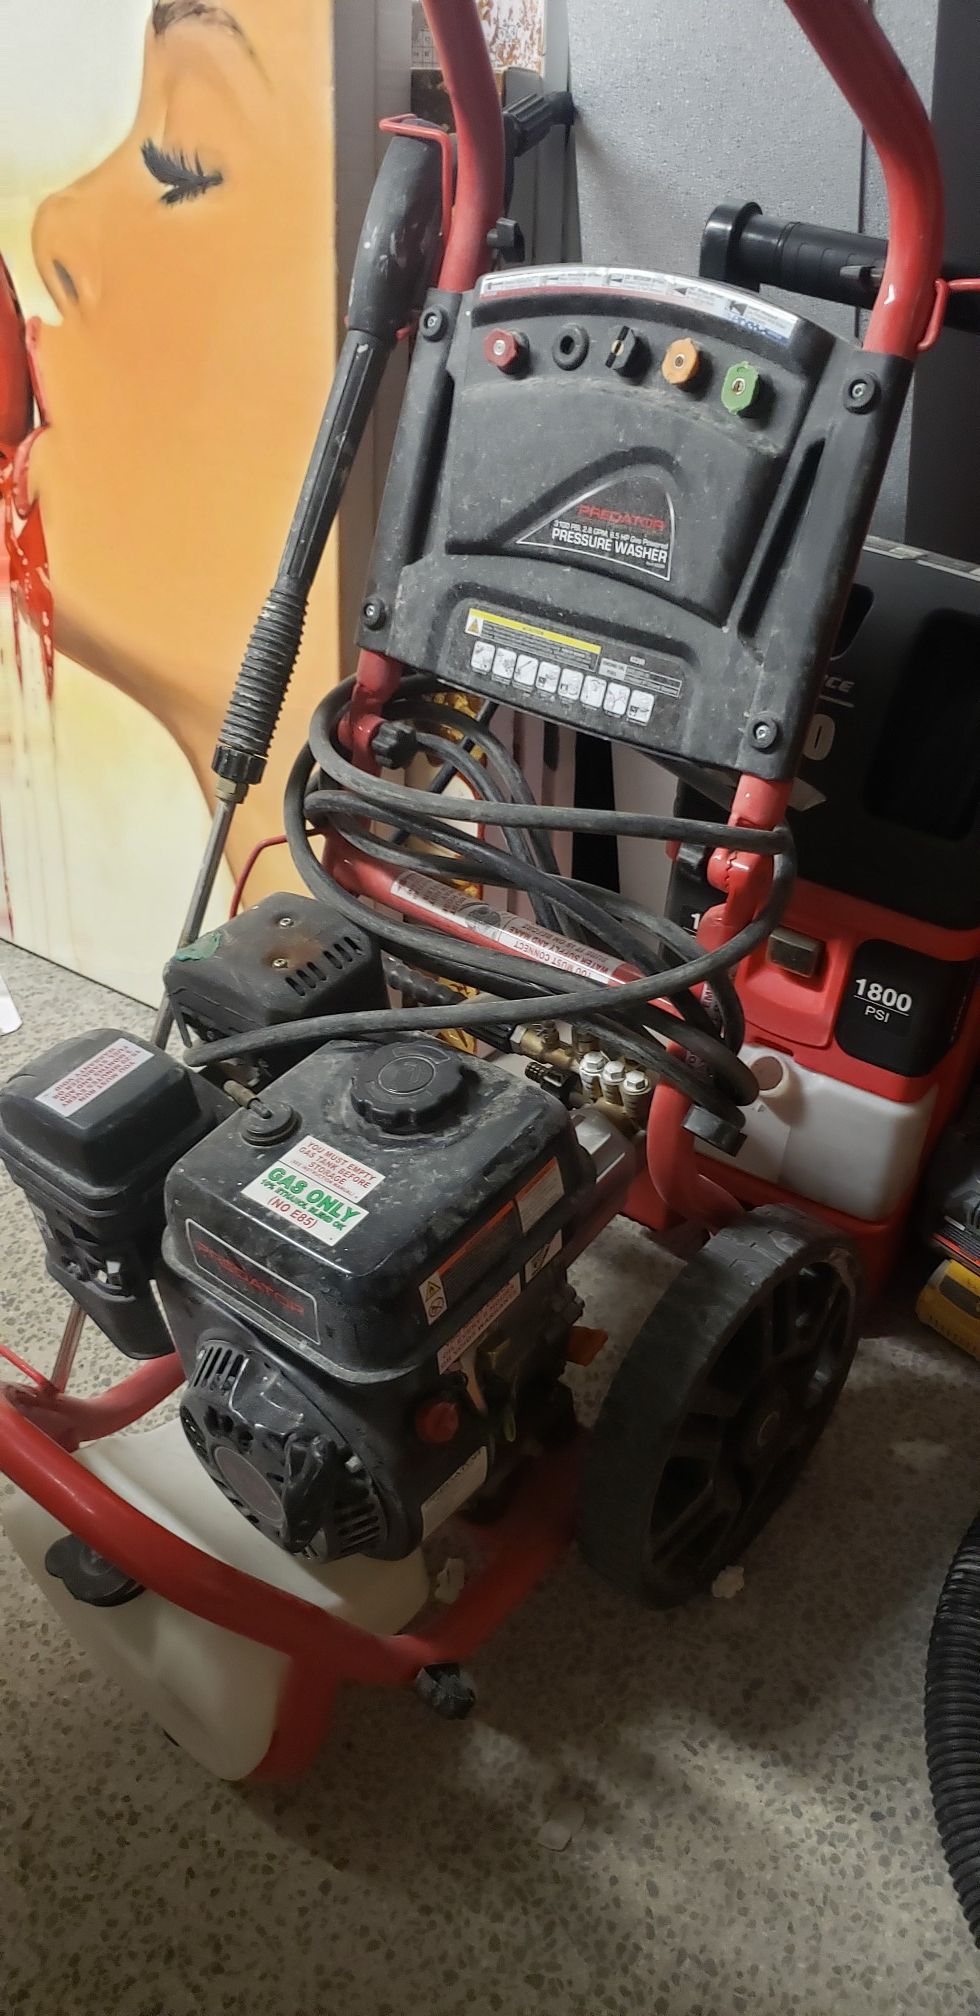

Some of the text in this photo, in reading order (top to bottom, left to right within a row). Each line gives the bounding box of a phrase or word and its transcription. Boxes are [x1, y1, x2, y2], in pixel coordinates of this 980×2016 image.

[577, 504, 667, 531] PREDATOR
[552, 527, 668, 563] PRESSURE WASHER
[642, 538, 669, 550] Powered
[825, 675, 855, 693] CE
[513, 940, 550, 961] CONNECT
[531, 936, 549, 948] AND
[549, 944, 581, 961] SUPPLY
[551, 957, 573, 971] MUST
[580, 955, 609, 974] WATER
[855, 978, 912, 1012] 1800
[865, 1005, 890, 1023] PSI
[299, 1146, 372, 1188] GAS TANK BEFORE
[307, 1141, 377, 1181] YOU MUST EMPTY
[308, 1161, 347, 1185] STORAGE
[268, 1167, 361, 1222] GAS ONLY
[267, 1195, 318, 1228] (NO E85)
[332, 1220, 347, 1231] OK
